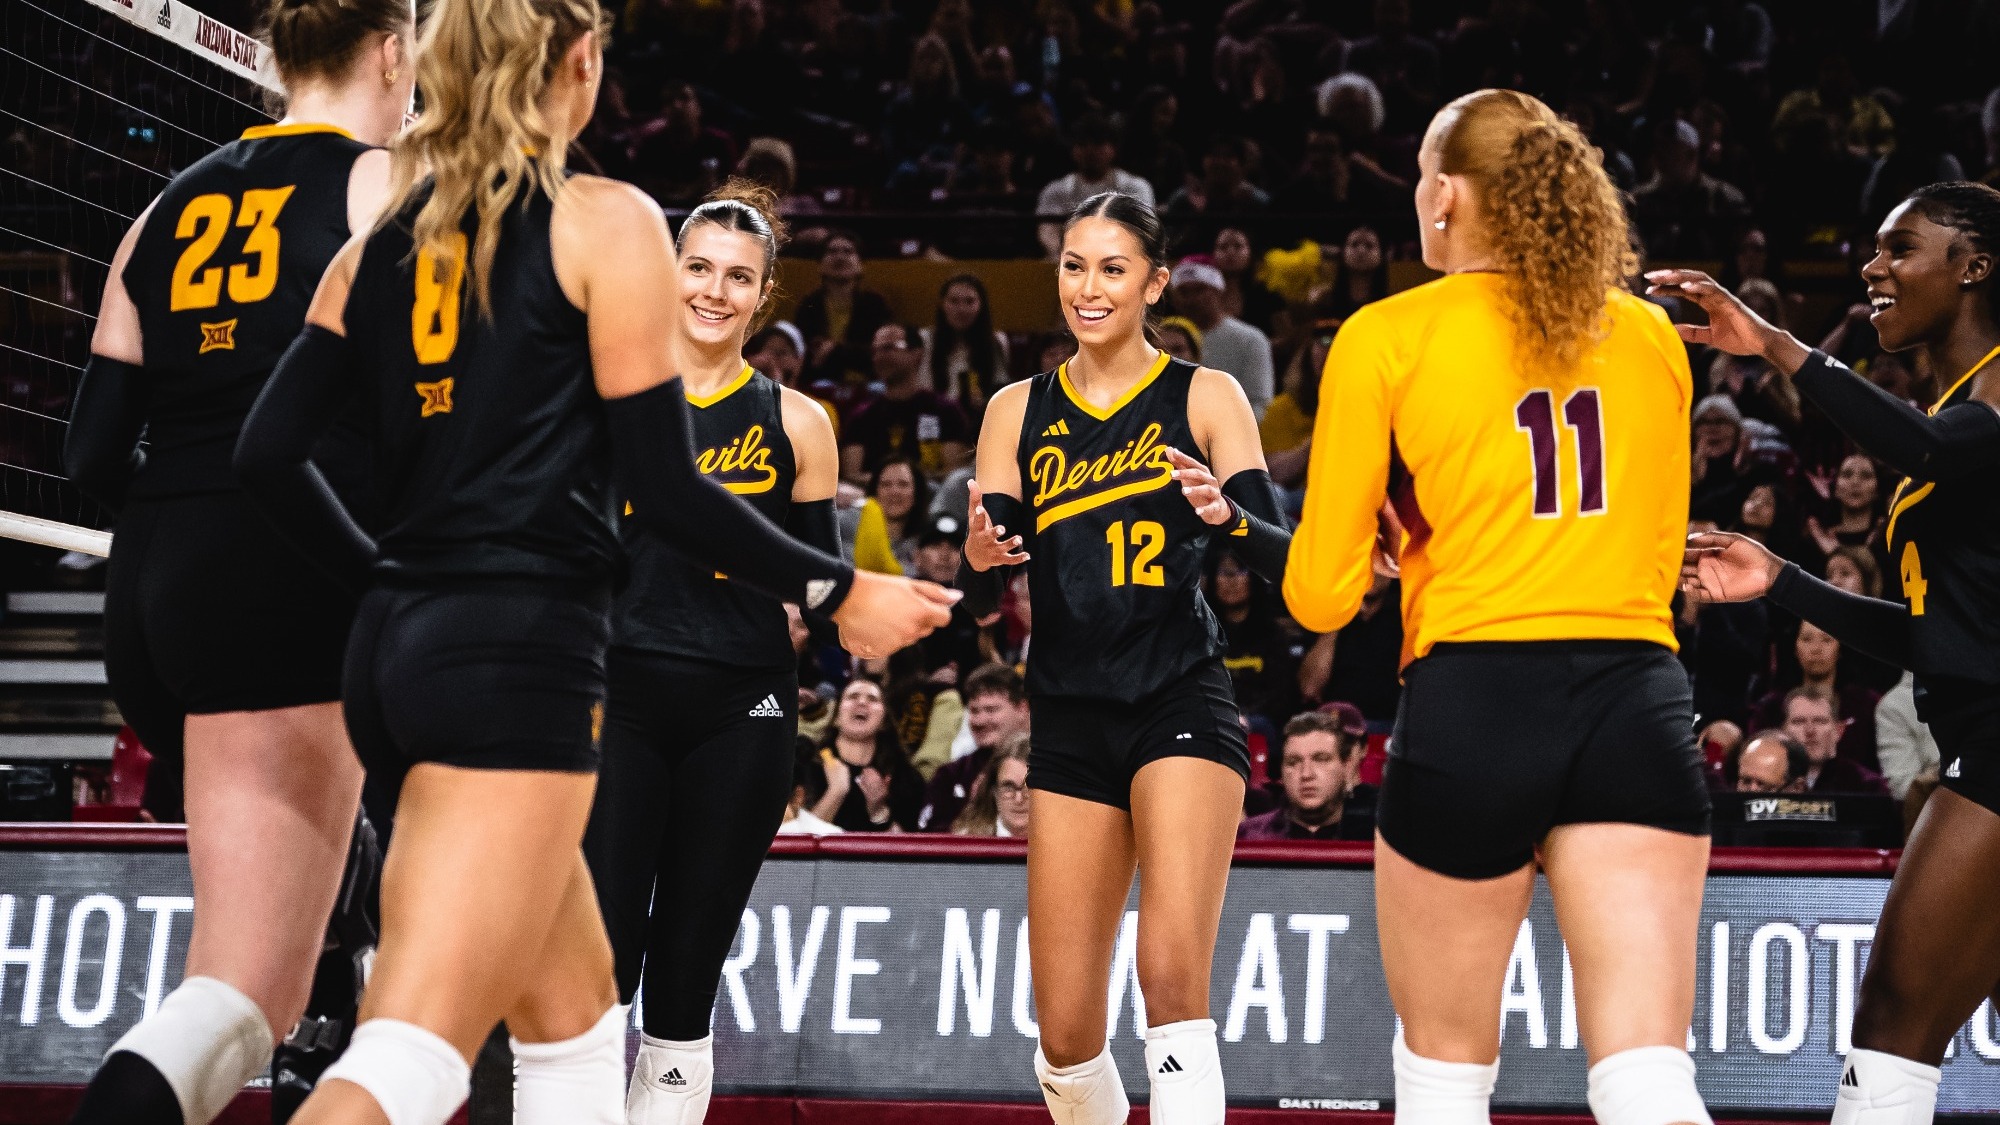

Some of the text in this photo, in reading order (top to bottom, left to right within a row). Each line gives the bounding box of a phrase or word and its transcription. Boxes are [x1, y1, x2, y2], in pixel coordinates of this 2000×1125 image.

[195, 14, 257, 72] ARIZONA STATE
[170, 185, 297, 312] 23
[411, 232, 467, 364] 8
[695, 425, 771, 474] vils
[1030, 422, 1175, 507] Devils
[1513, 387, 1608, 519] 11
[1106, 520, 1165, 587] 12
[1901, 541, 1928, 616] 4
[749, 707, 784, 718] adidas
[1222, 912, 1350, 1044] AT
[659, 1077, 687, 1086] adidas
[1279, 1098, 1380, 1111] DAKTRONICS
